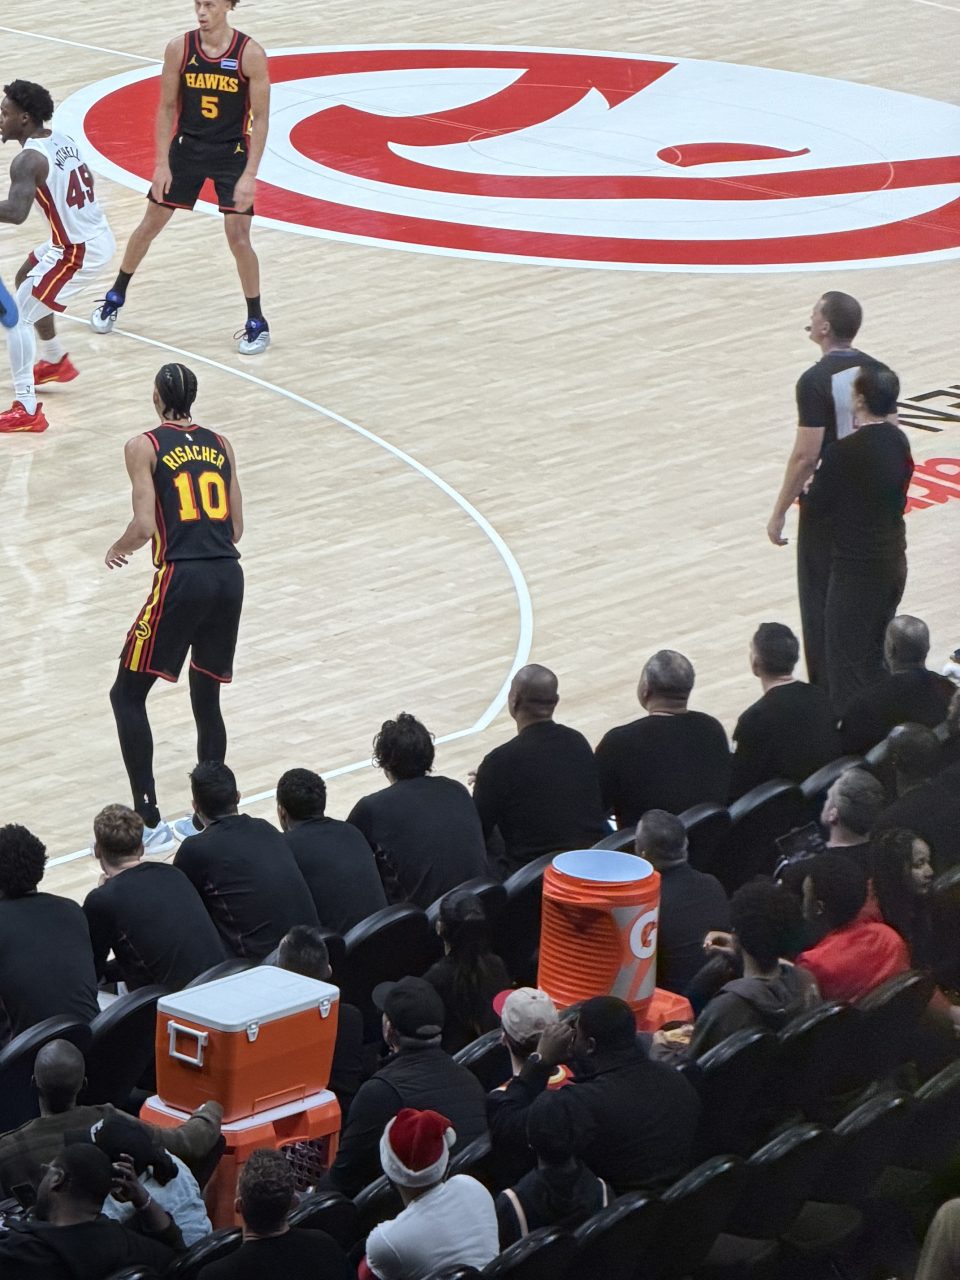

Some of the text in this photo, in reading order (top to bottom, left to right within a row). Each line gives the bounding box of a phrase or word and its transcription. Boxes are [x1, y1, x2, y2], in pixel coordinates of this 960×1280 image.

[185, 72, 239, 93] HAWKS
[201, 95, 219, 119] 5
[162, 445, 225, 471] RISACHER
[172, 470, 230, 522] 10
[629, 908, 658, 960] G
